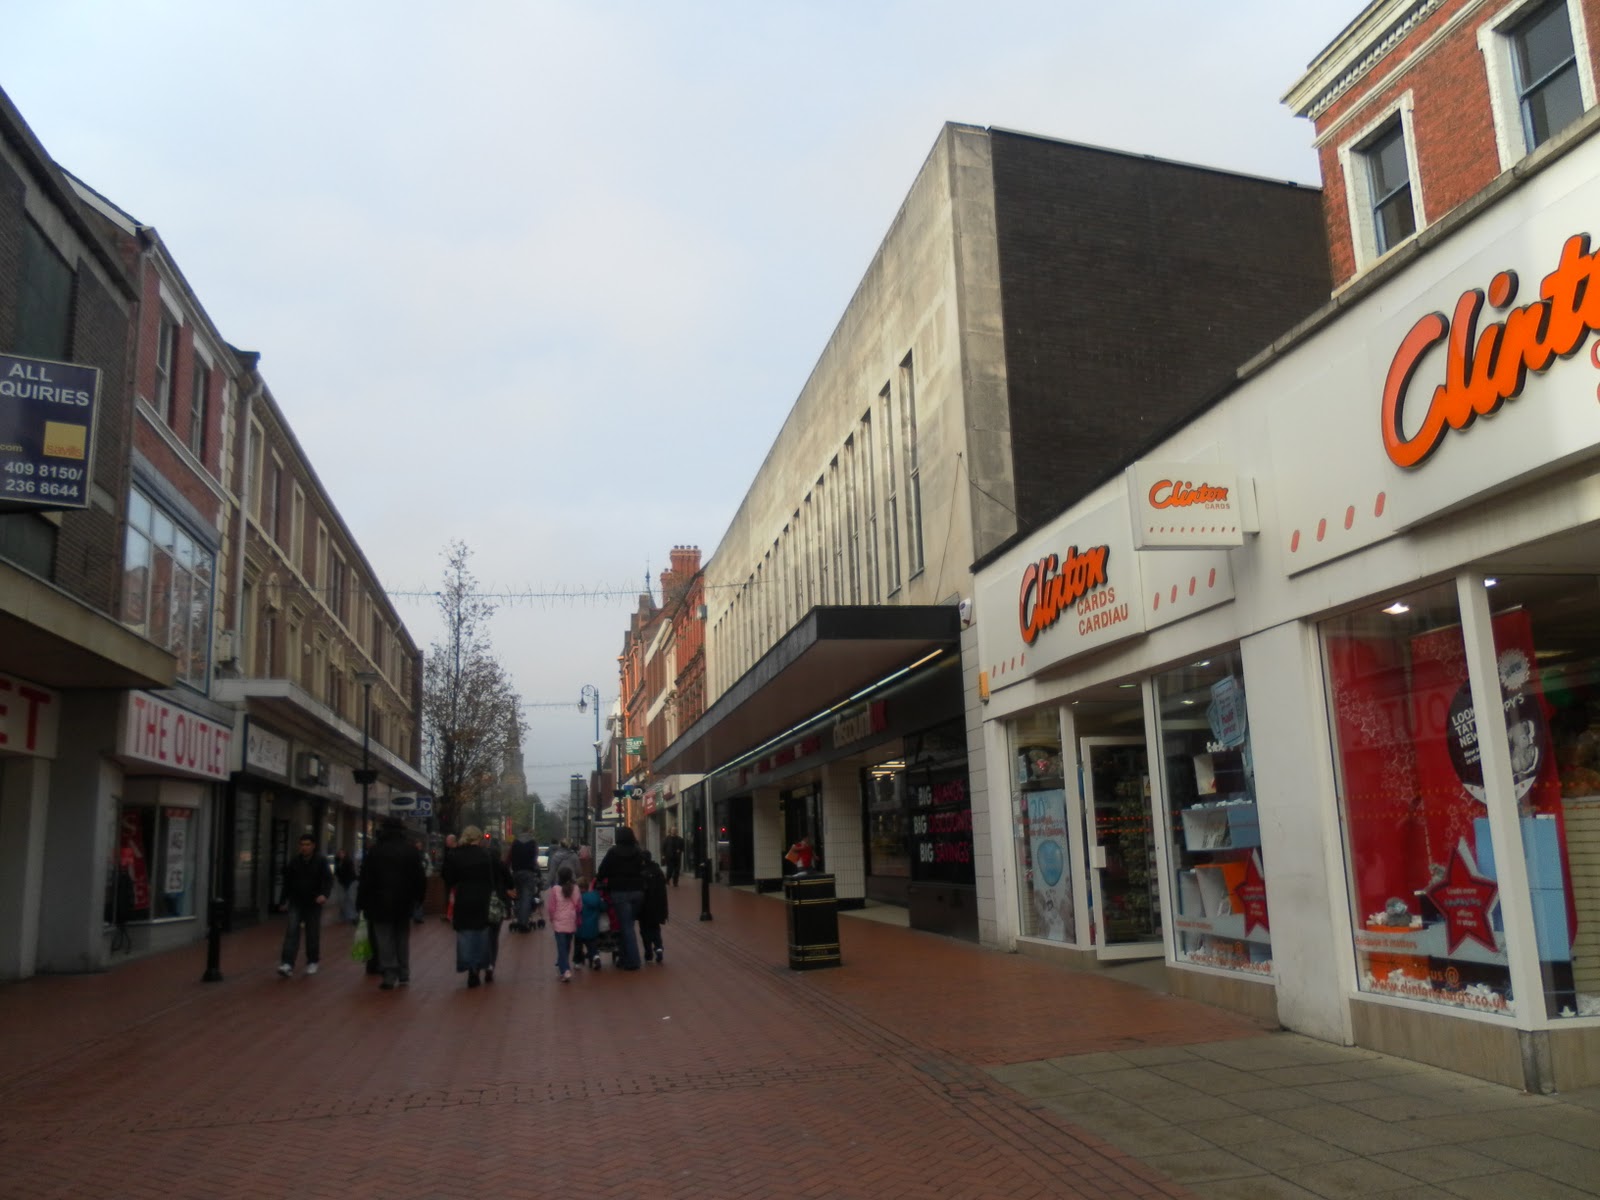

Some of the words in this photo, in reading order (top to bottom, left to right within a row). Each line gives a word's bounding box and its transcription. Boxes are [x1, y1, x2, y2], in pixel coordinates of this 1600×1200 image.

[1381, 232, 1600, 470] Clint
[8, 363, 53, 382] ALL
[0, 380, 90, 407] QUIRIES
[4, 461, 34, 475] 409
[38, 464, 83, 481] 8150/
[5, 479, 35, 493] 236
[39, 482, 79, 498] 8644
[1148, 478, 1229, 509] Clinton
[1019, 545, 1110, 645] Clinton
[1076, 586, 1116, 617] CARDS
[1078, 604, 1130, 637] CARDIAU
[134, 696, 169, 761] THE
[174, 713, 230, 776] OUTLET
[918, 785, 932, 806] BIG
[913, 815, 927, 834] BIG
[919, 842, 934, 863] BIG
